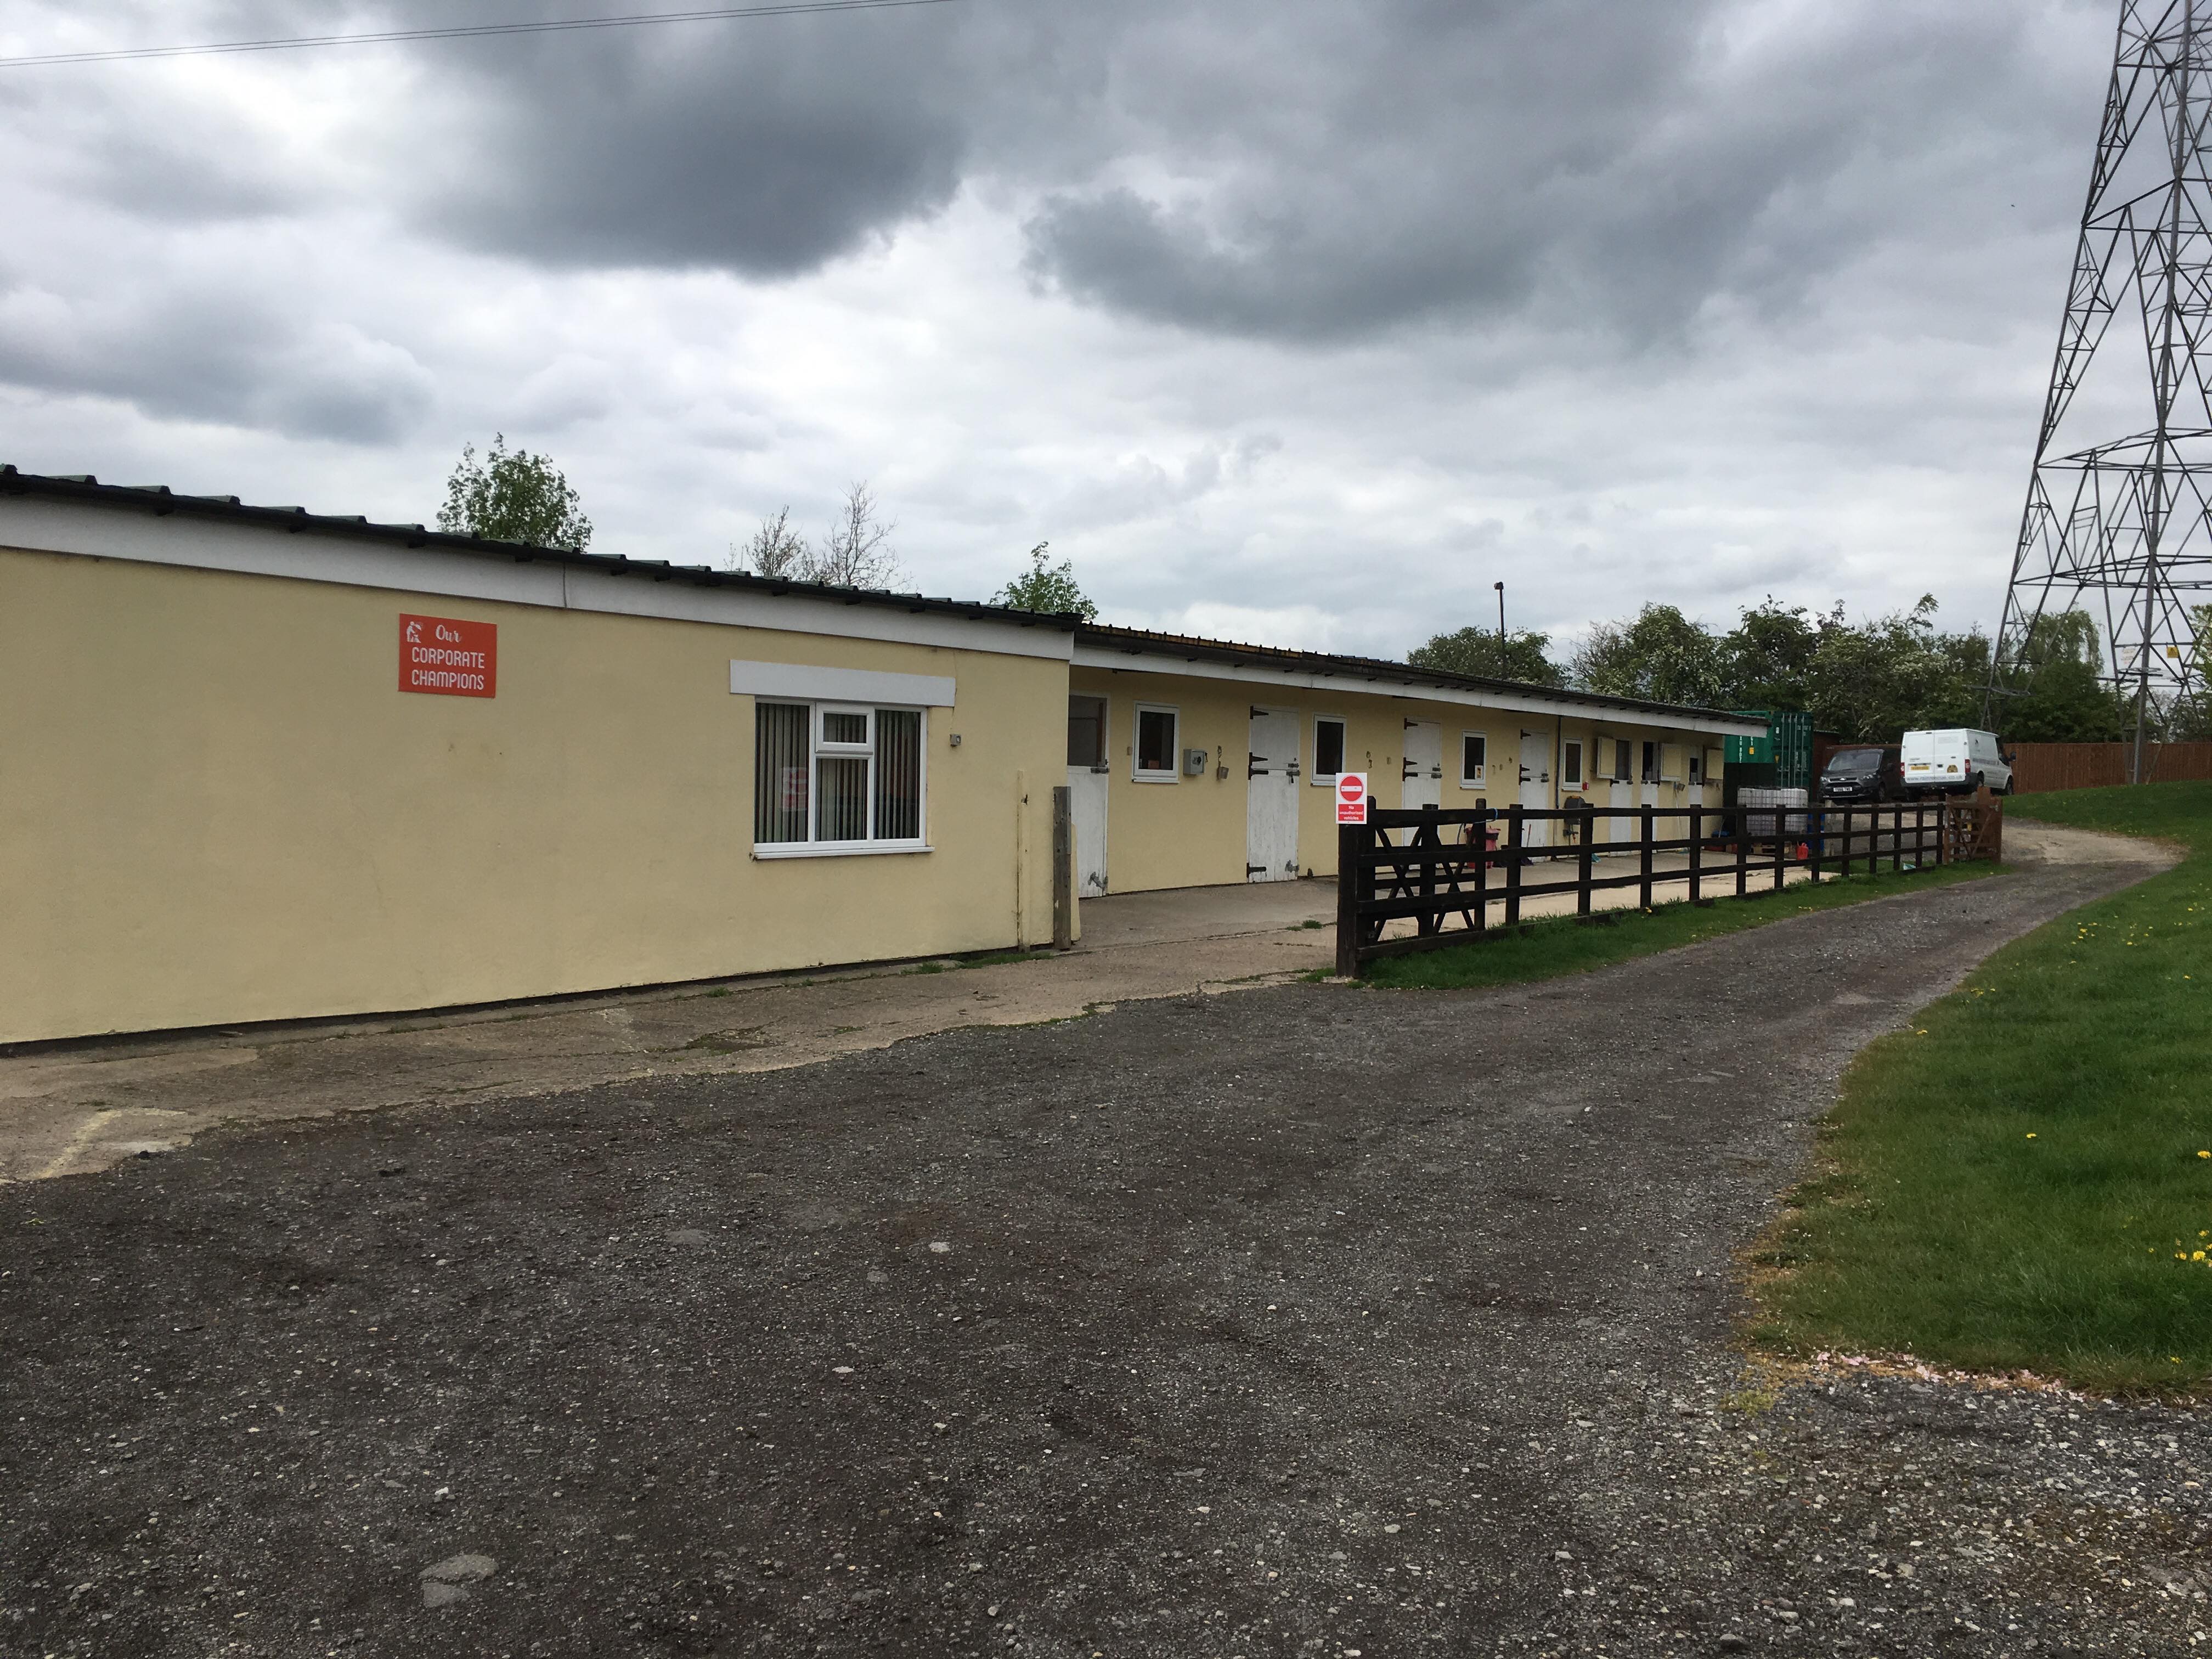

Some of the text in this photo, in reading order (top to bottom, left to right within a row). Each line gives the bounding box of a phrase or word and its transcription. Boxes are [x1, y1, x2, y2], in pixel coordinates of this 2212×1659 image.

[436, 624, 462, 643] Our
[412, 646, 485, 669] CORPORATE
[412, 669, 484, 690] CHAMPIONS
